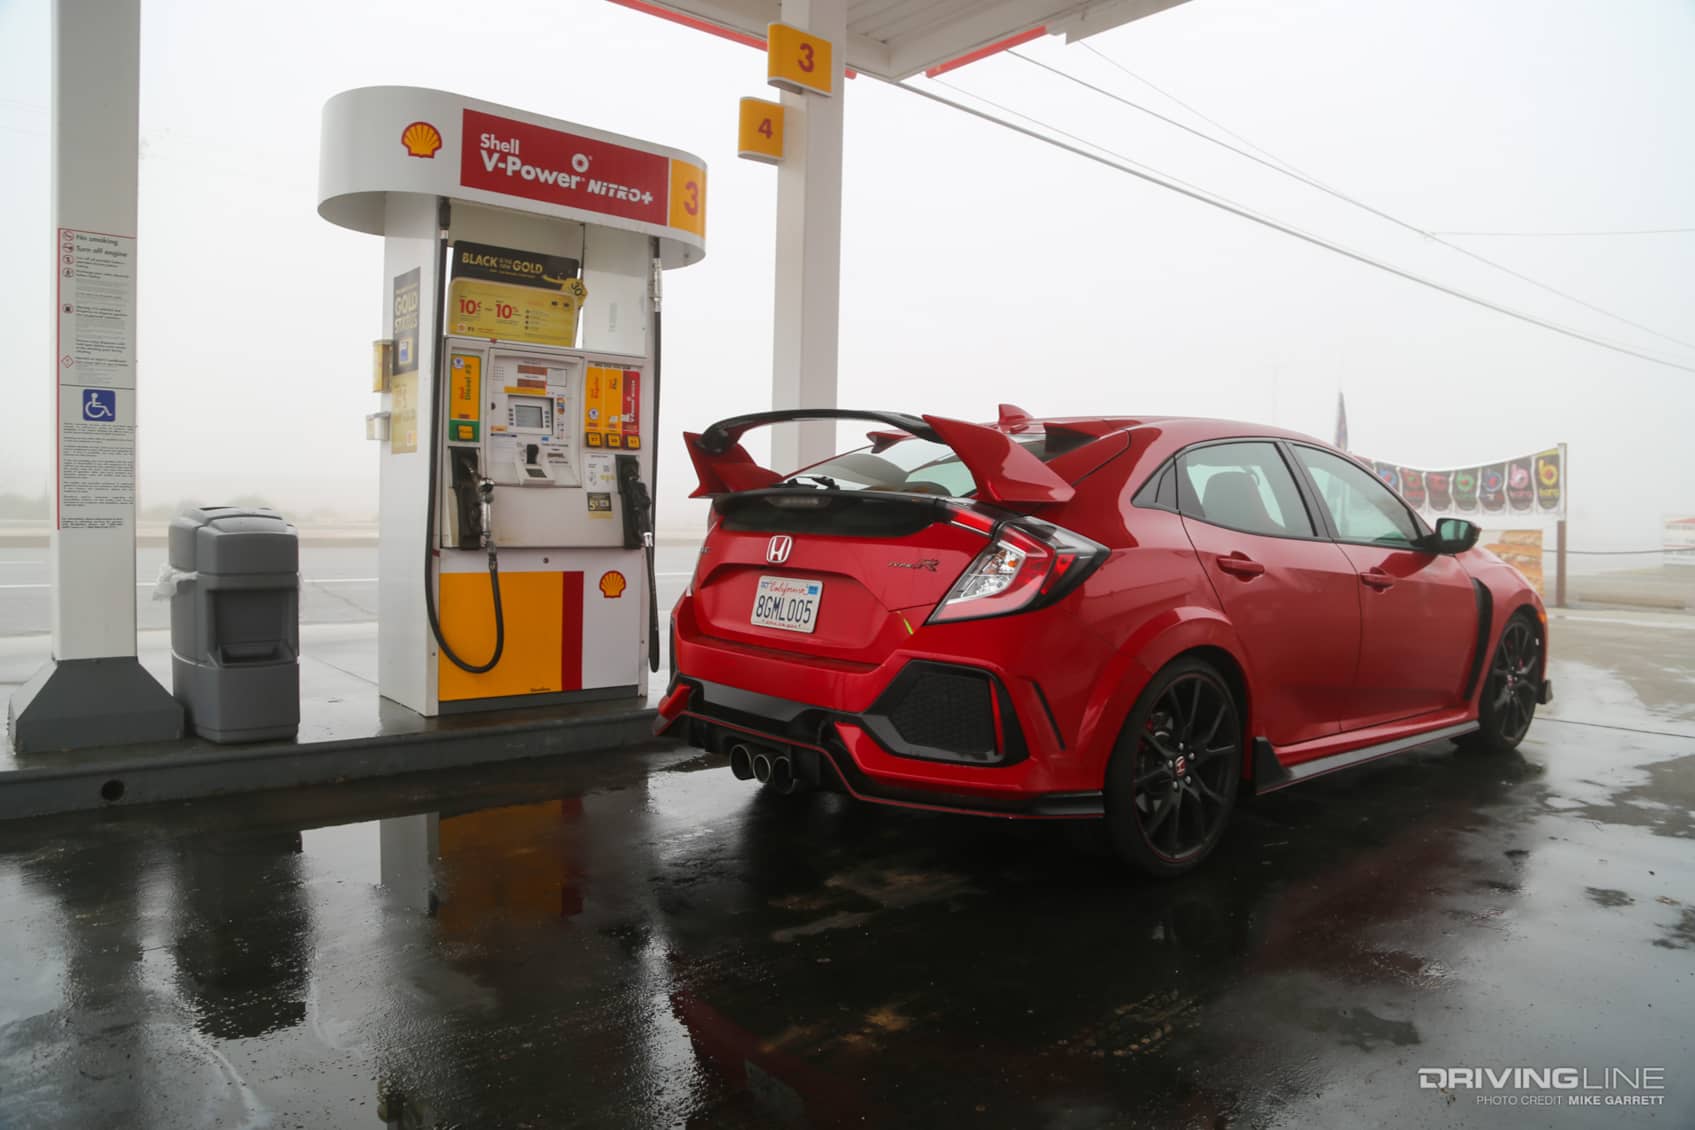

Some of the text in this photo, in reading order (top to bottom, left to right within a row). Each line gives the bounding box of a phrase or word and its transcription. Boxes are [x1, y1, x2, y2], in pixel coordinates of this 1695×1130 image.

[798, 42, 814, 72] 3
[757, 118, 773, 139] 4
[480, 133, 519, 155] Shell
[480, 149, 582, 190] V-Power
[684, 181, 699, 216] 3
[462, 252, 498, 267] BLACK
[512, 260, 544, 274] GOLD
[769, 581, 808, 596] California
[756, 594, 813, 624] 8GML005
